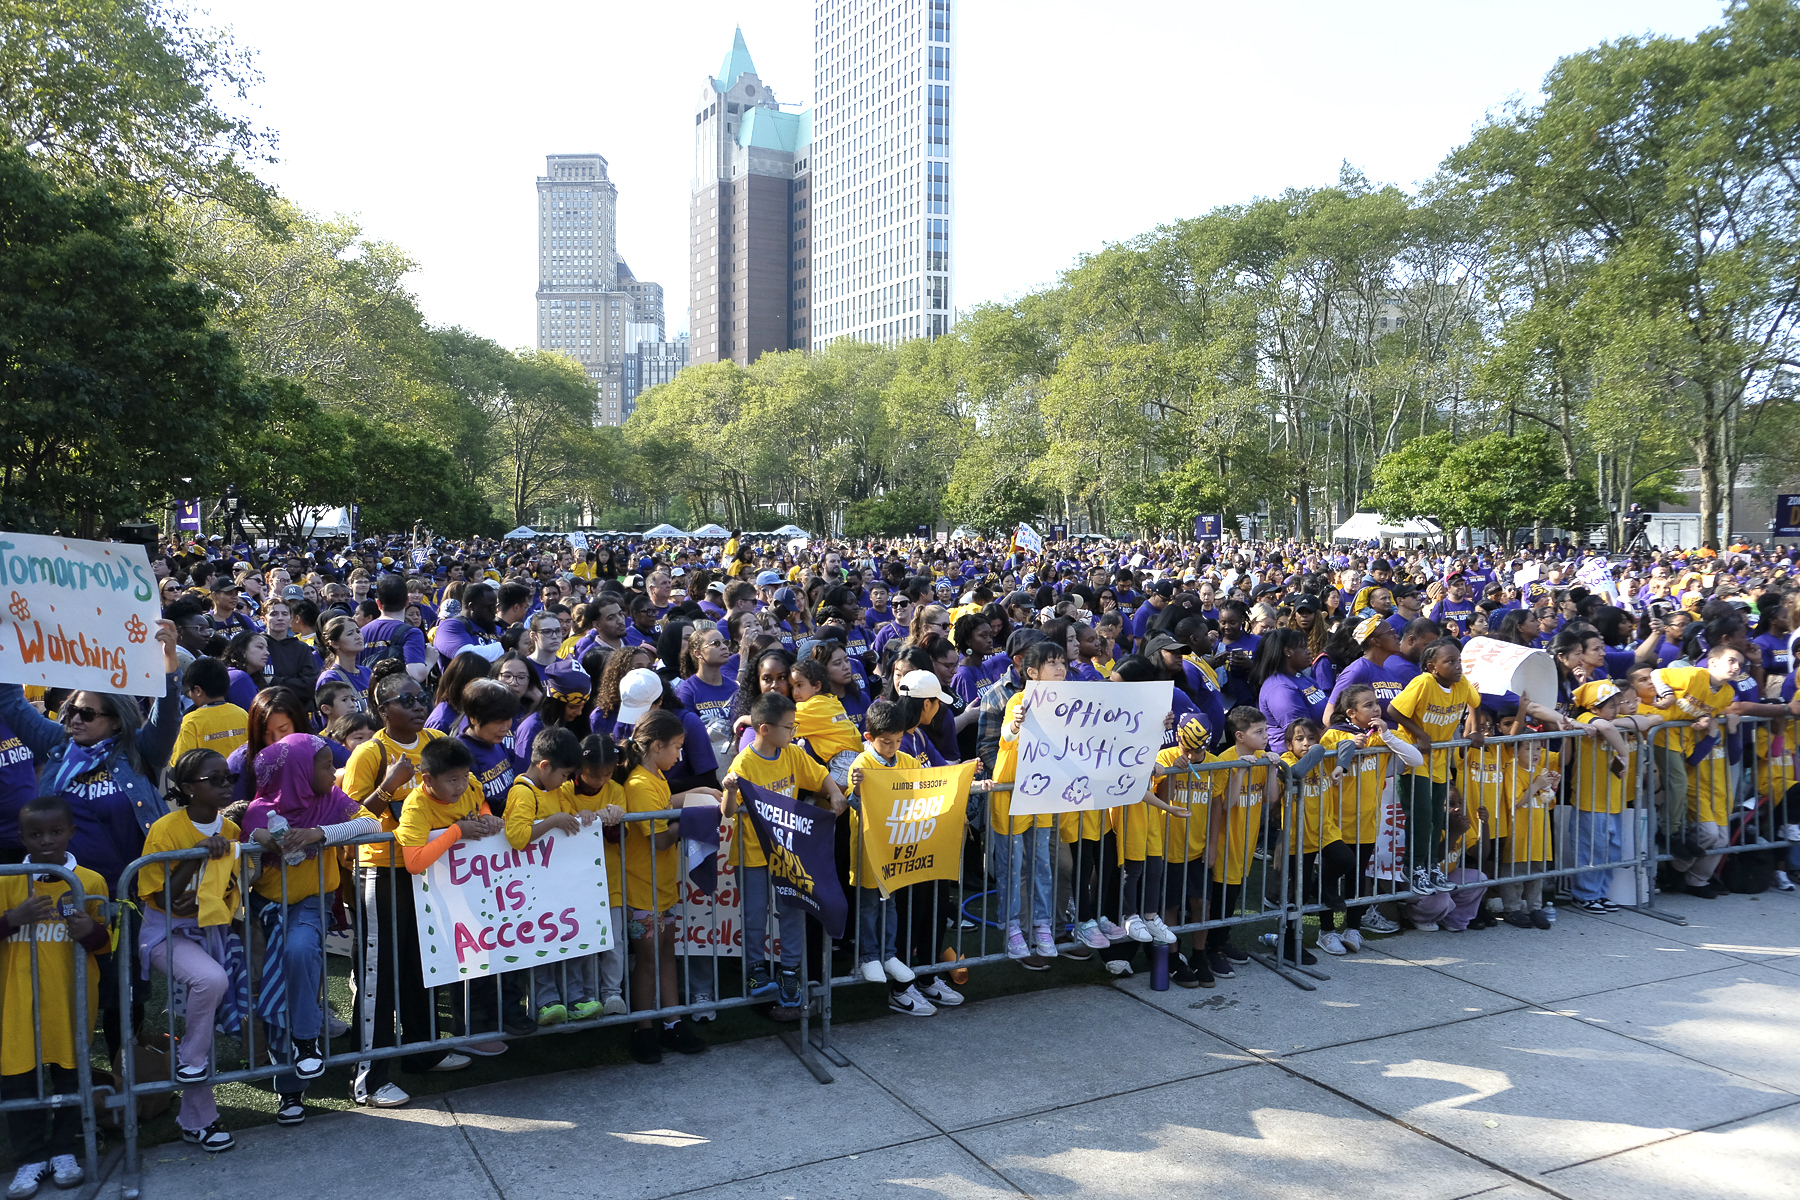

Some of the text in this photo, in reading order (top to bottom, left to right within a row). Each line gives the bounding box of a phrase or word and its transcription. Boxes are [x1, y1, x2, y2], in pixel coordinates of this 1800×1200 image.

[1205, 522, 1212, 533] F
[13, 620, 128, 689] Watching
[1025, 686, 1058, 712] No
[1022, 738, 1051, 764] No
[1053, 735, 1150, 770] Justice
[755, 800, 814, 836] EXCELLENCE
[886, 795, 945, 821] RIGHT
[773, 826, 793, 851] IS A
[885, 818, 937, 844] CIVIL
[449, 836, 555, 888] Equity
[893, 844, 918, 860] IS A
[881, 854, 934, 881] EXCELLENC
